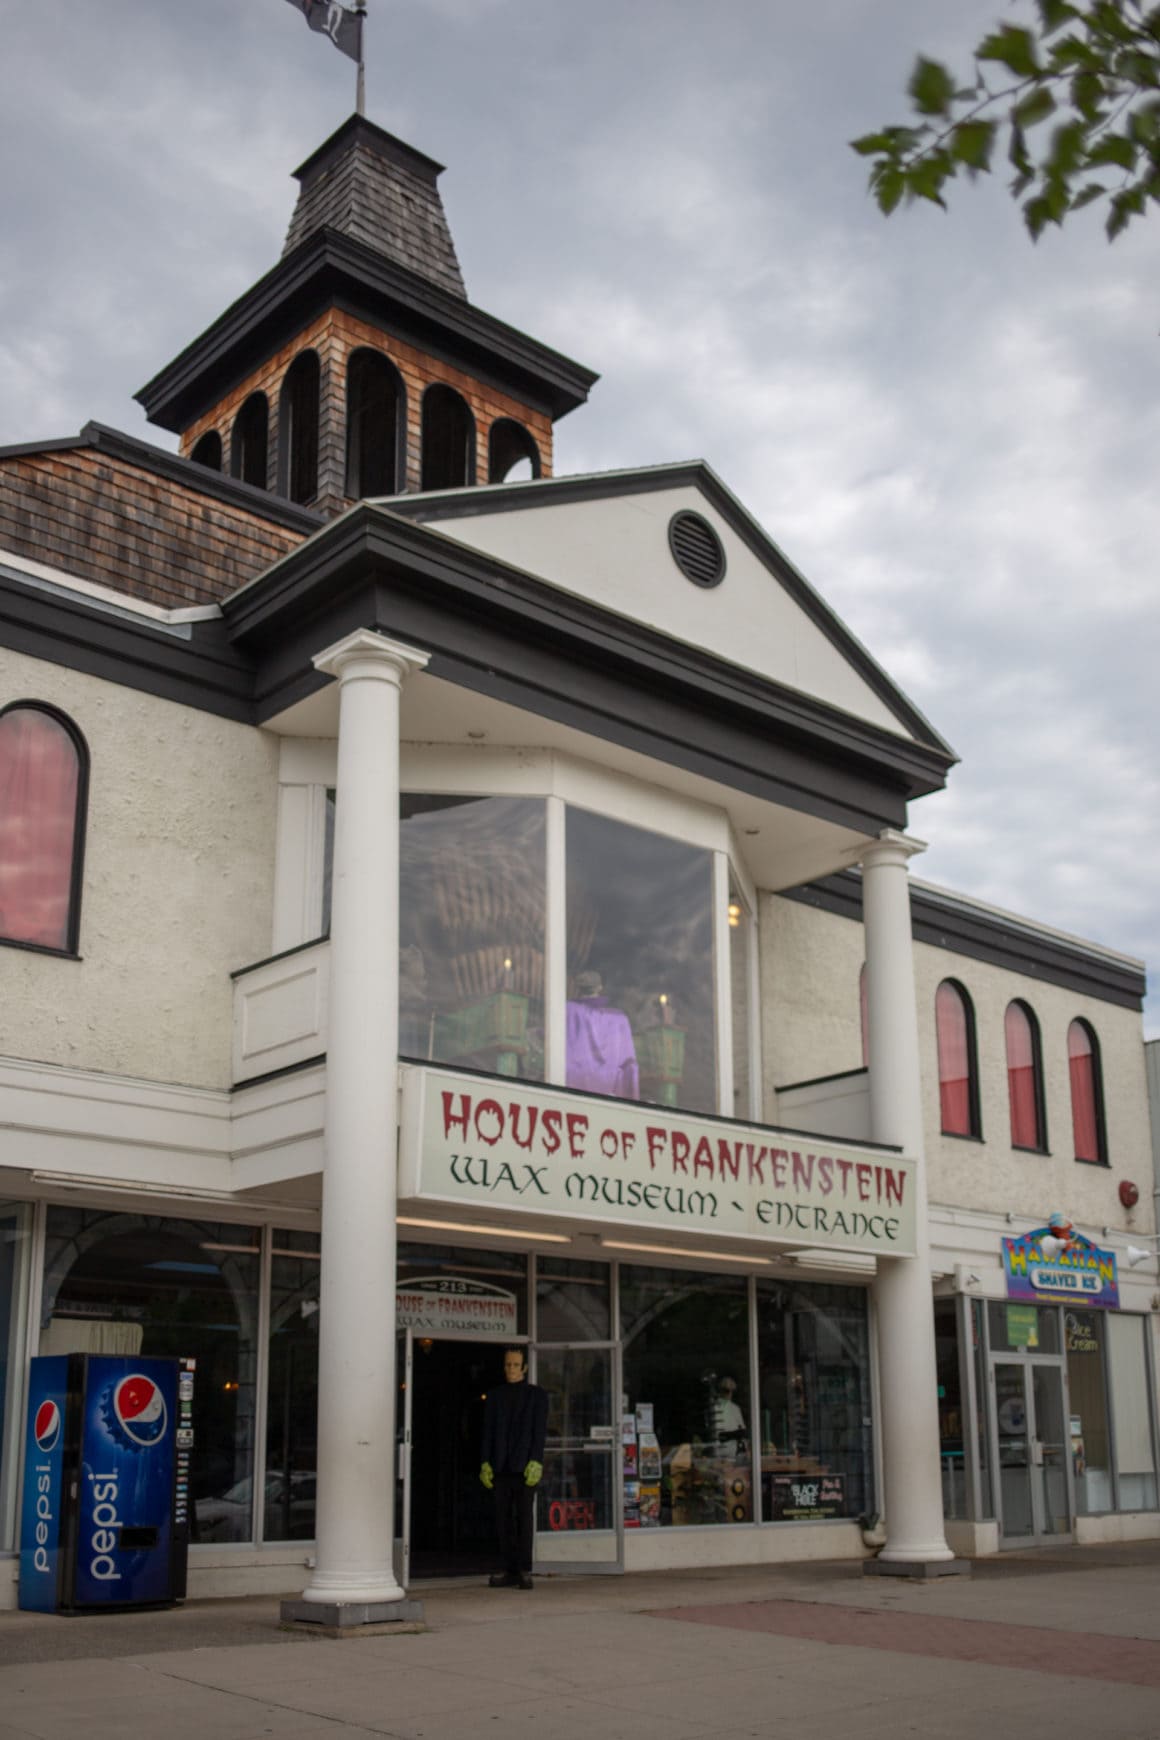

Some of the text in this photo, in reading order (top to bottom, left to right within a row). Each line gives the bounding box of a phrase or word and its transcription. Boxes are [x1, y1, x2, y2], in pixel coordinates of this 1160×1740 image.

[441, 1090, 907, 1207] HOUSE OF FRANKENSTEIN
[450, 1154, 550, 1195] WAX
[564, 1171, 719, 1218] MUSEUM
[756, 1199, 900, 1241] ENTRANCE
[396, 1294, 424, 1313] OUSE
[438, 1296, 515, 1319] FRANKENSTEIN
[440, 1281, 467, 1293] 213
[34, 1464, 52, 1572] pepsi
[88, 1472, 124, 1580] pepsi
[549, 1500, 596, 1531] OPEN
